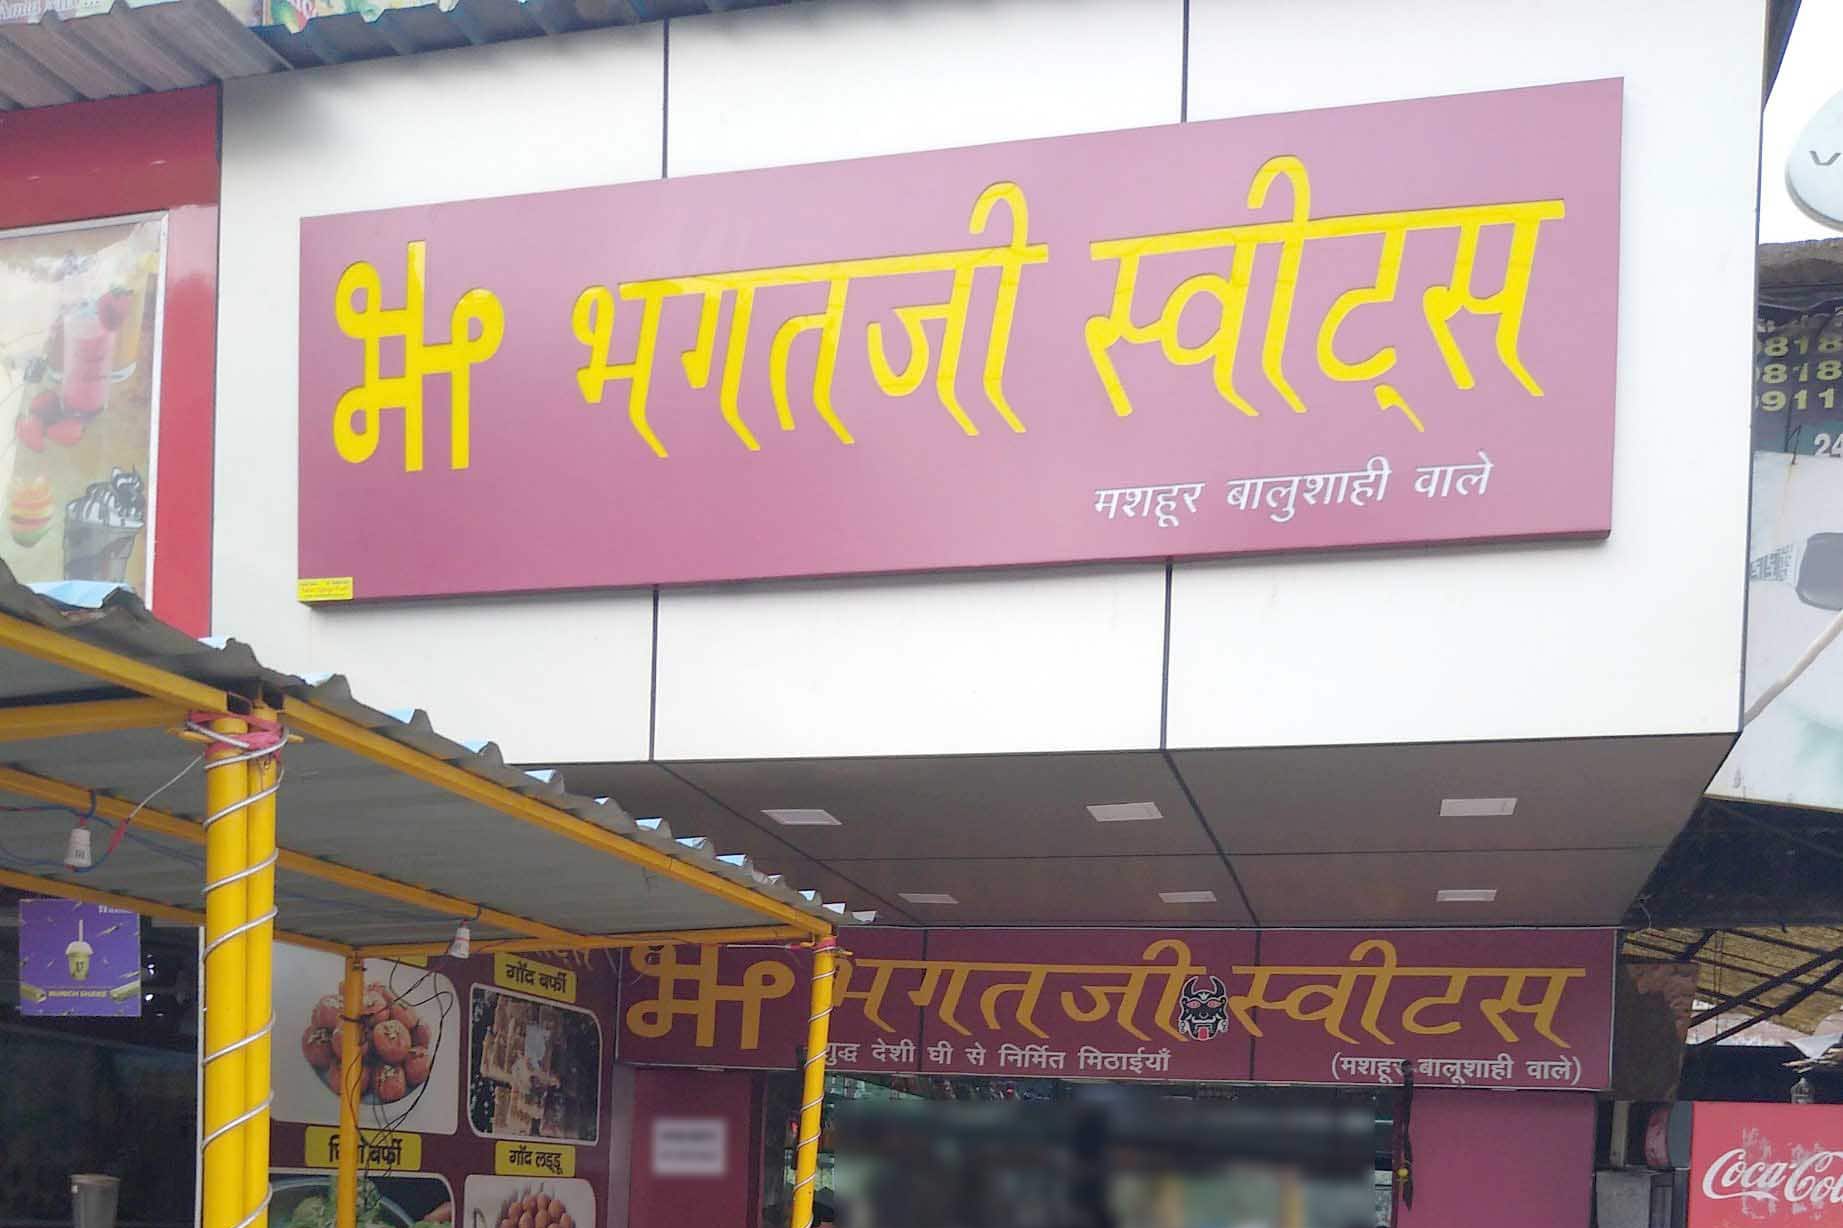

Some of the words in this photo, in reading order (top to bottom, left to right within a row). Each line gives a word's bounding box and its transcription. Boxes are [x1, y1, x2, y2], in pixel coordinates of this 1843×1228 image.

[1755, 360, 1842, 384] 818
[1094, 482, 1206, 528] मशहूर
[1413, 451, 1495, 499] वाले
[871, 1038, 916, 1063] देशी
[927, 1039, 954, 1065] घी
[965, 1041, 986, 1067] से
[998, 1043, 1068, 1071] निर्मित
